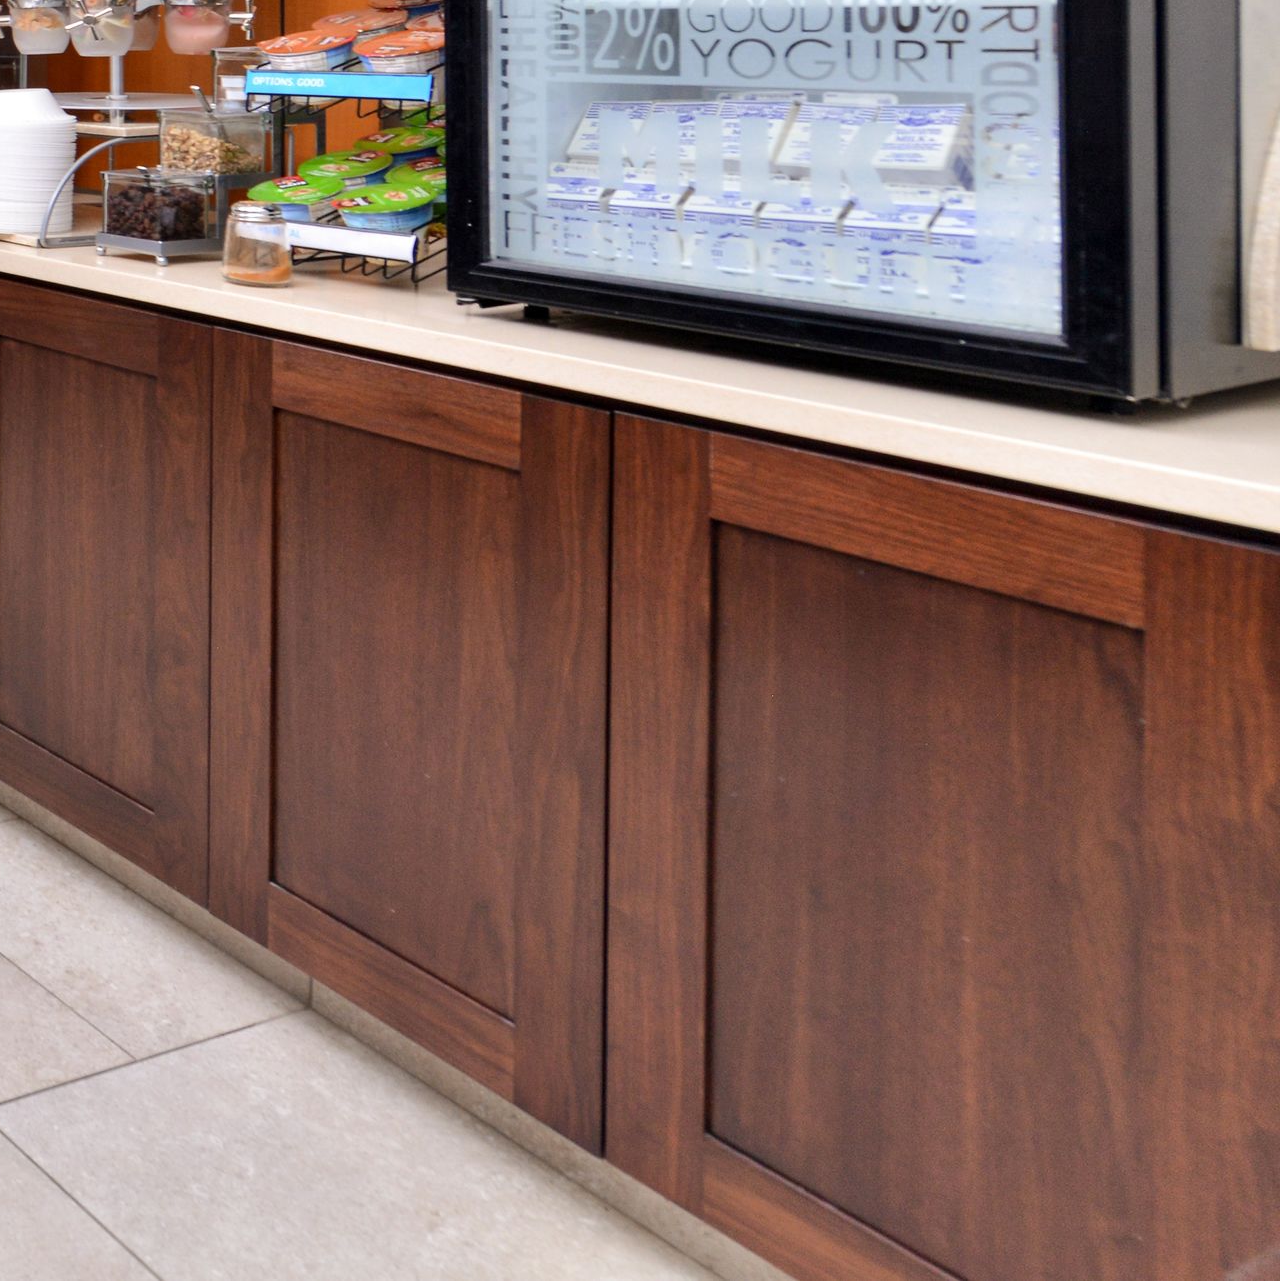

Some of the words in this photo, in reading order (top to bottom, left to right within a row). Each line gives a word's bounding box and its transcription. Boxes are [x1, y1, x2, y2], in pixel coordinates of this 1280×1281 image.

[593, 5, 676, 71] 2%
[690, 37, 967, 83] YOGURT
[252, 76, 294, 87] OPTIONS.
[296, 77, 326, 88] GOOD.
